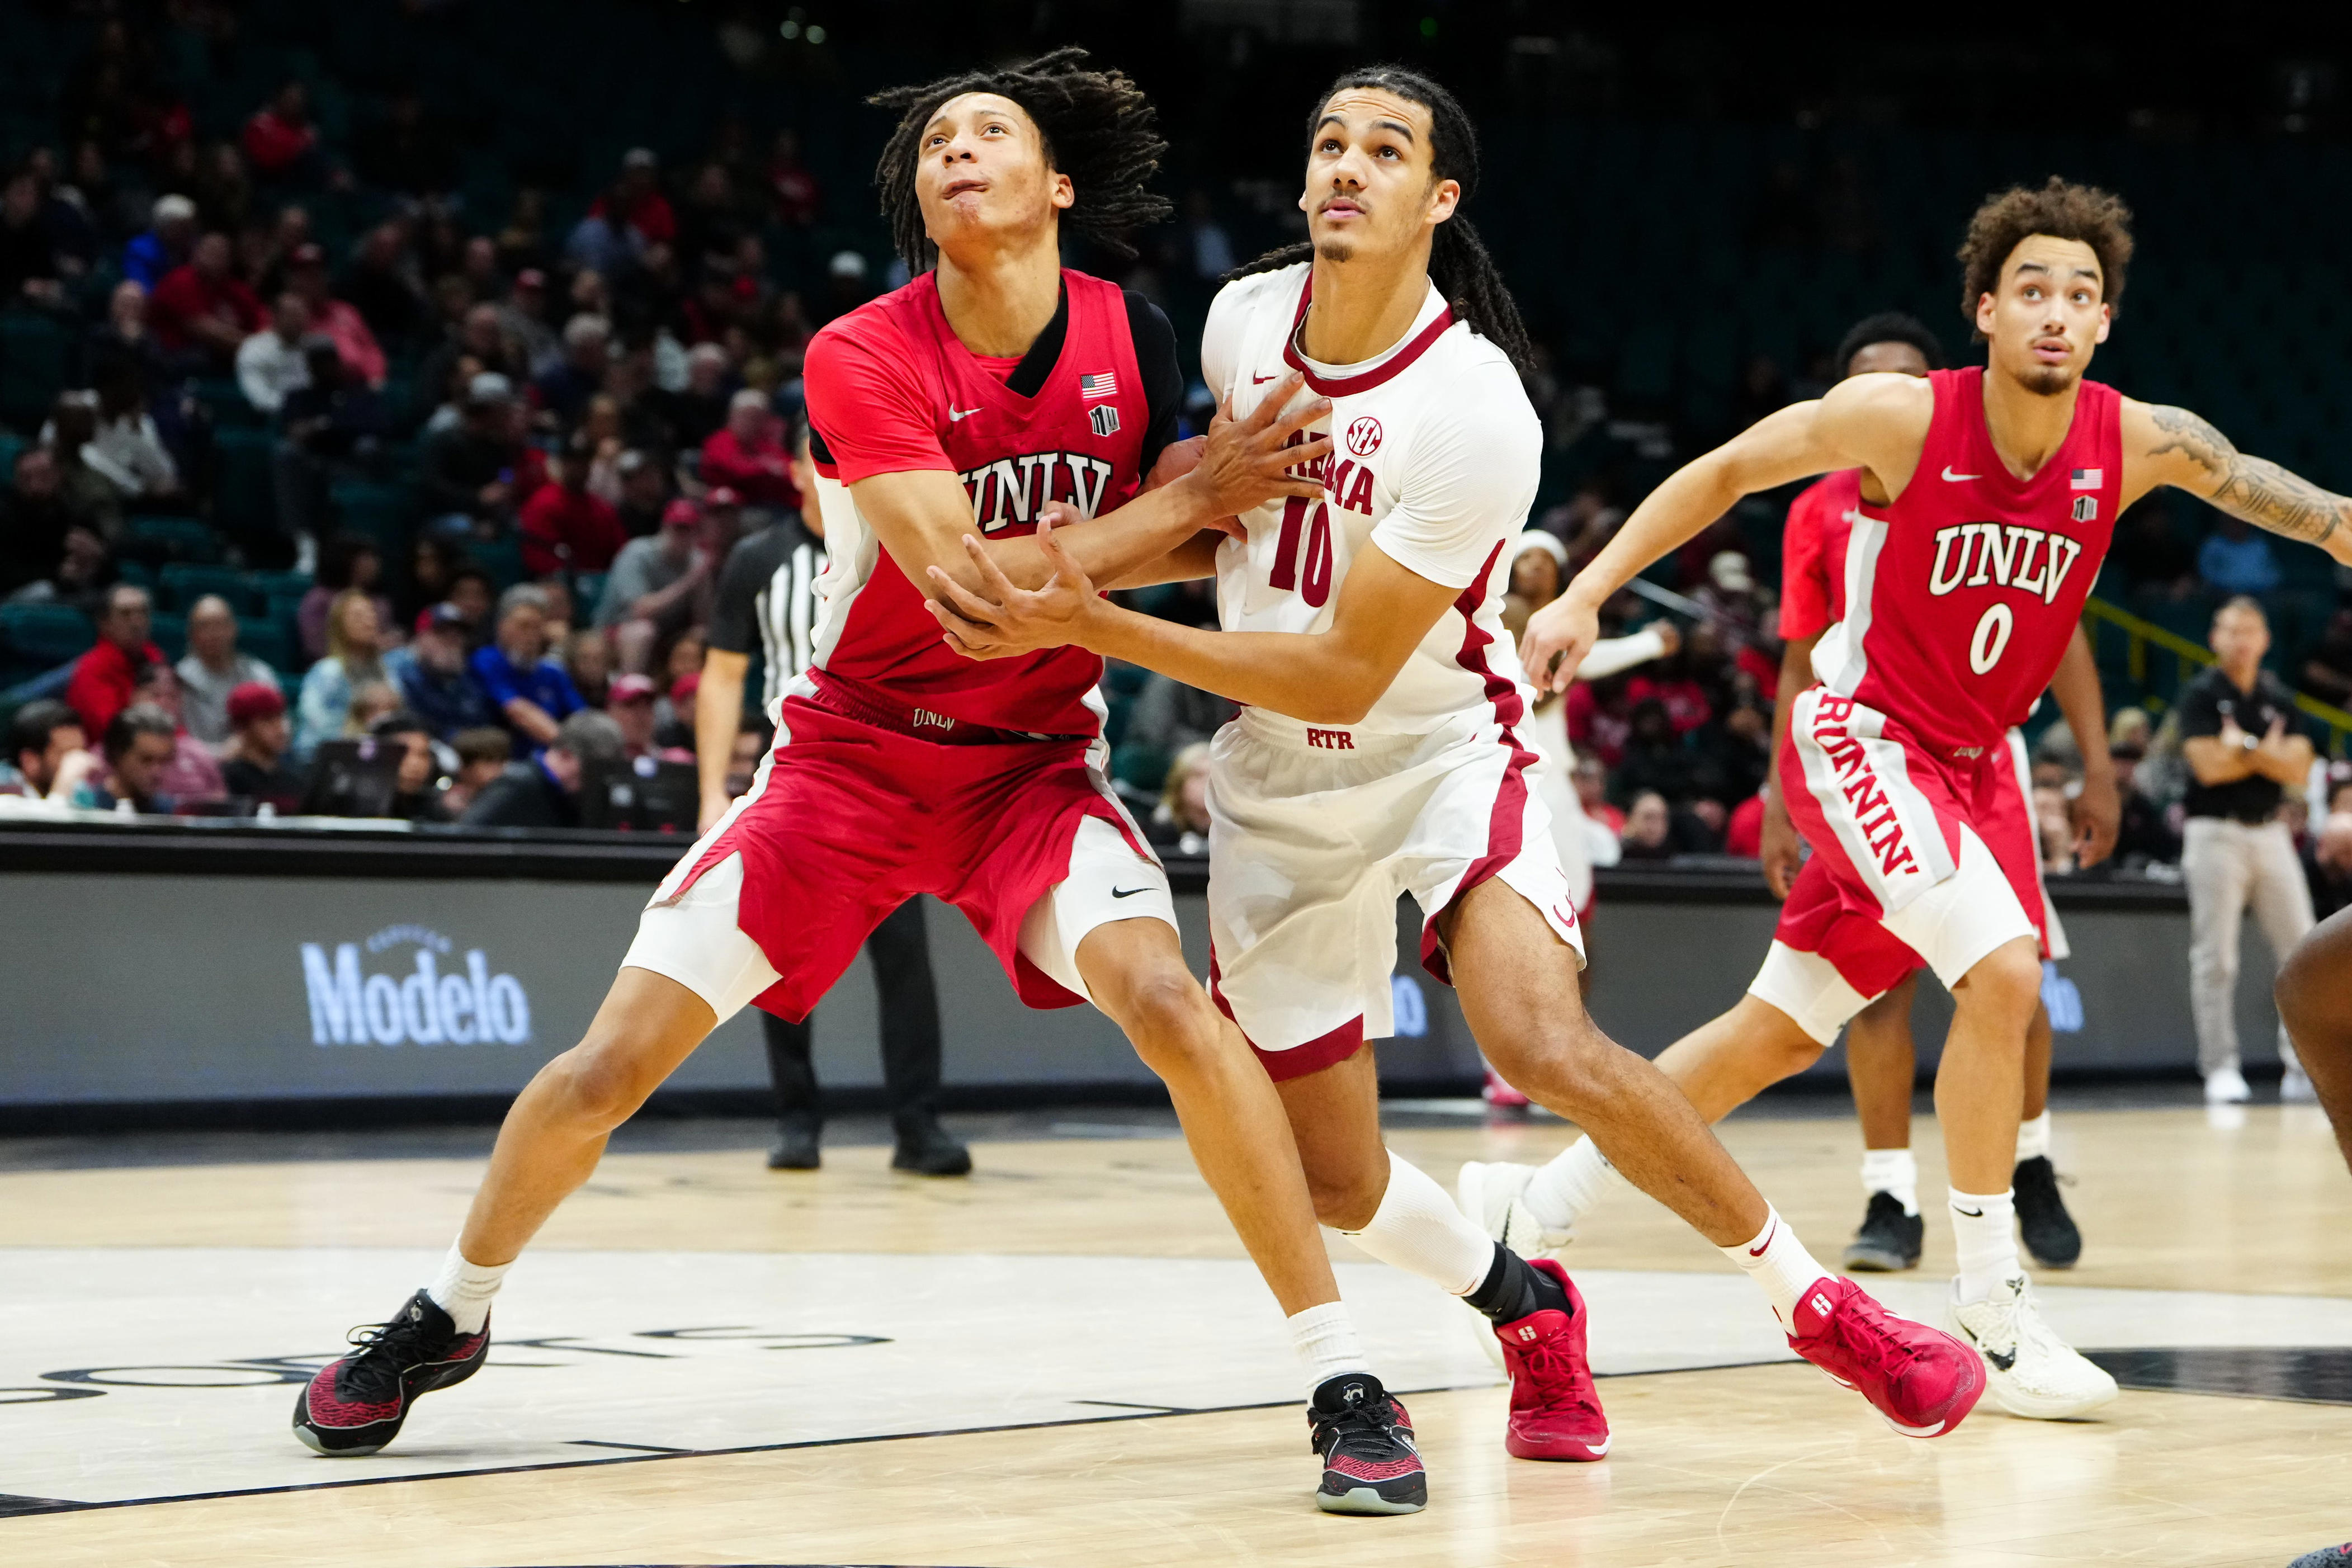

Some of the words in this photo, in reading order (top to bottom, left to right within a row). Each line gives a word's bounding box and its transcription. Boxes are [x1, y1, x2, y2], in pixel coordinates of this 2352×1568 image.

[1346, 416, 1382, 456] SEC
[1269, 495, 1333, 608] 10
[1928, 522, 2082, 606] UNLV
[1969, 602, 2014, 676] 0
[913, 707, 955, 731] UNLV
[1306, 728, 1355, 749] RTR
[300, 942, 531, 1045] Modelo
